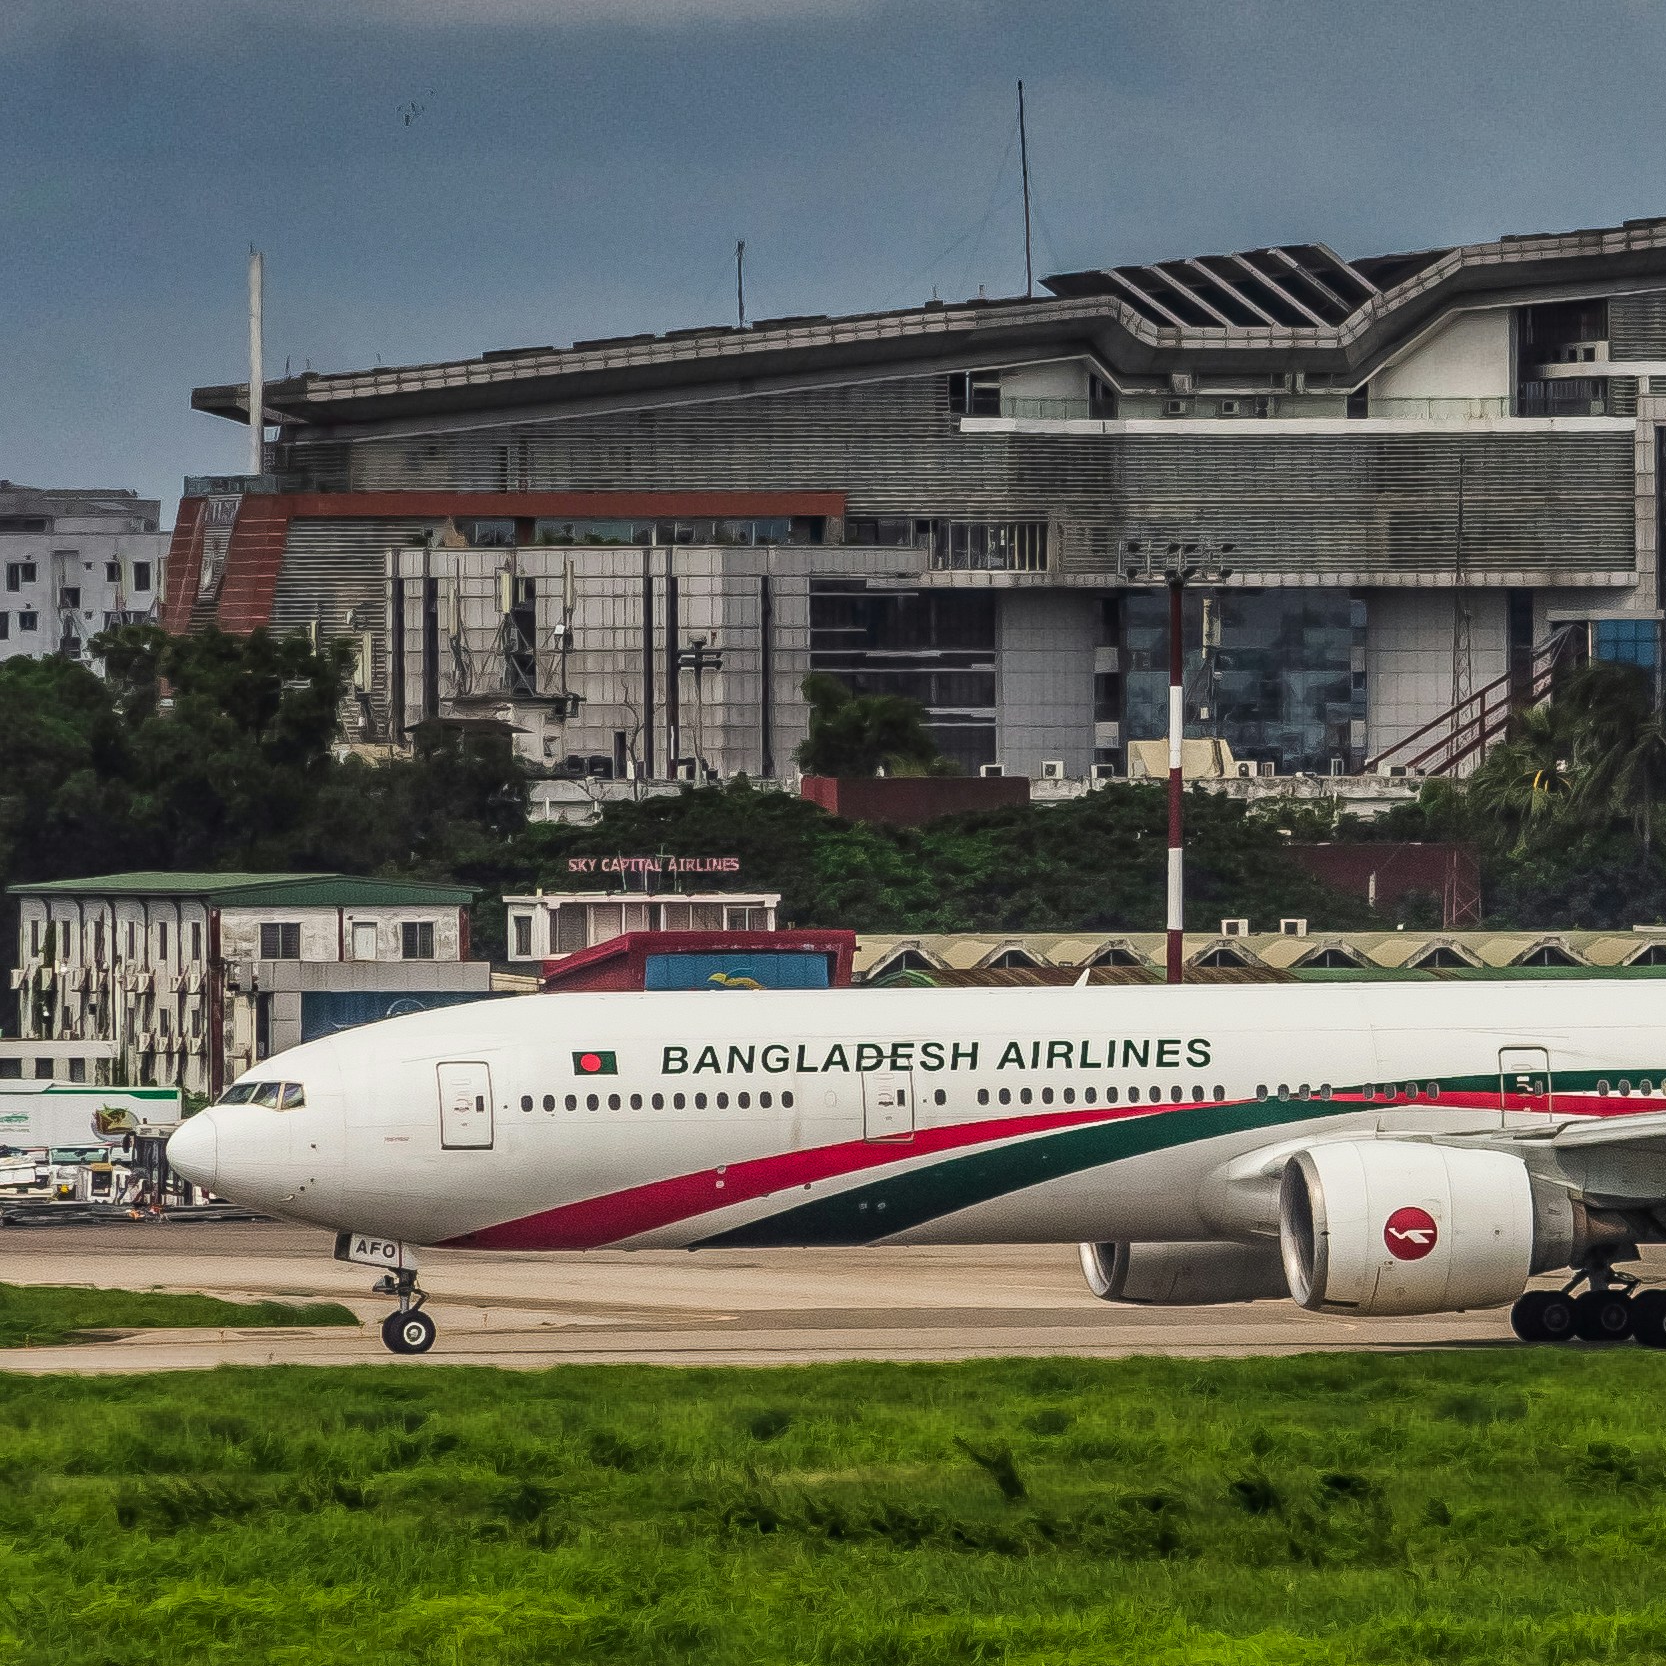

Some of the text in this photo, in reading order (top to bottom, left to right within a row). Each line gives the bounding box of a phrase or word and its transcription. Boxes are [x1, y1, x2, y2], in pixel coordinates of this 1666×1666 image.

[568, 857, 740, 872] SKY CAPITAL AIRLINES
[661, 1038, 1212, 1075] BANGLADESH AIRLINES
[355, 1238, 396, 1259] AFO
